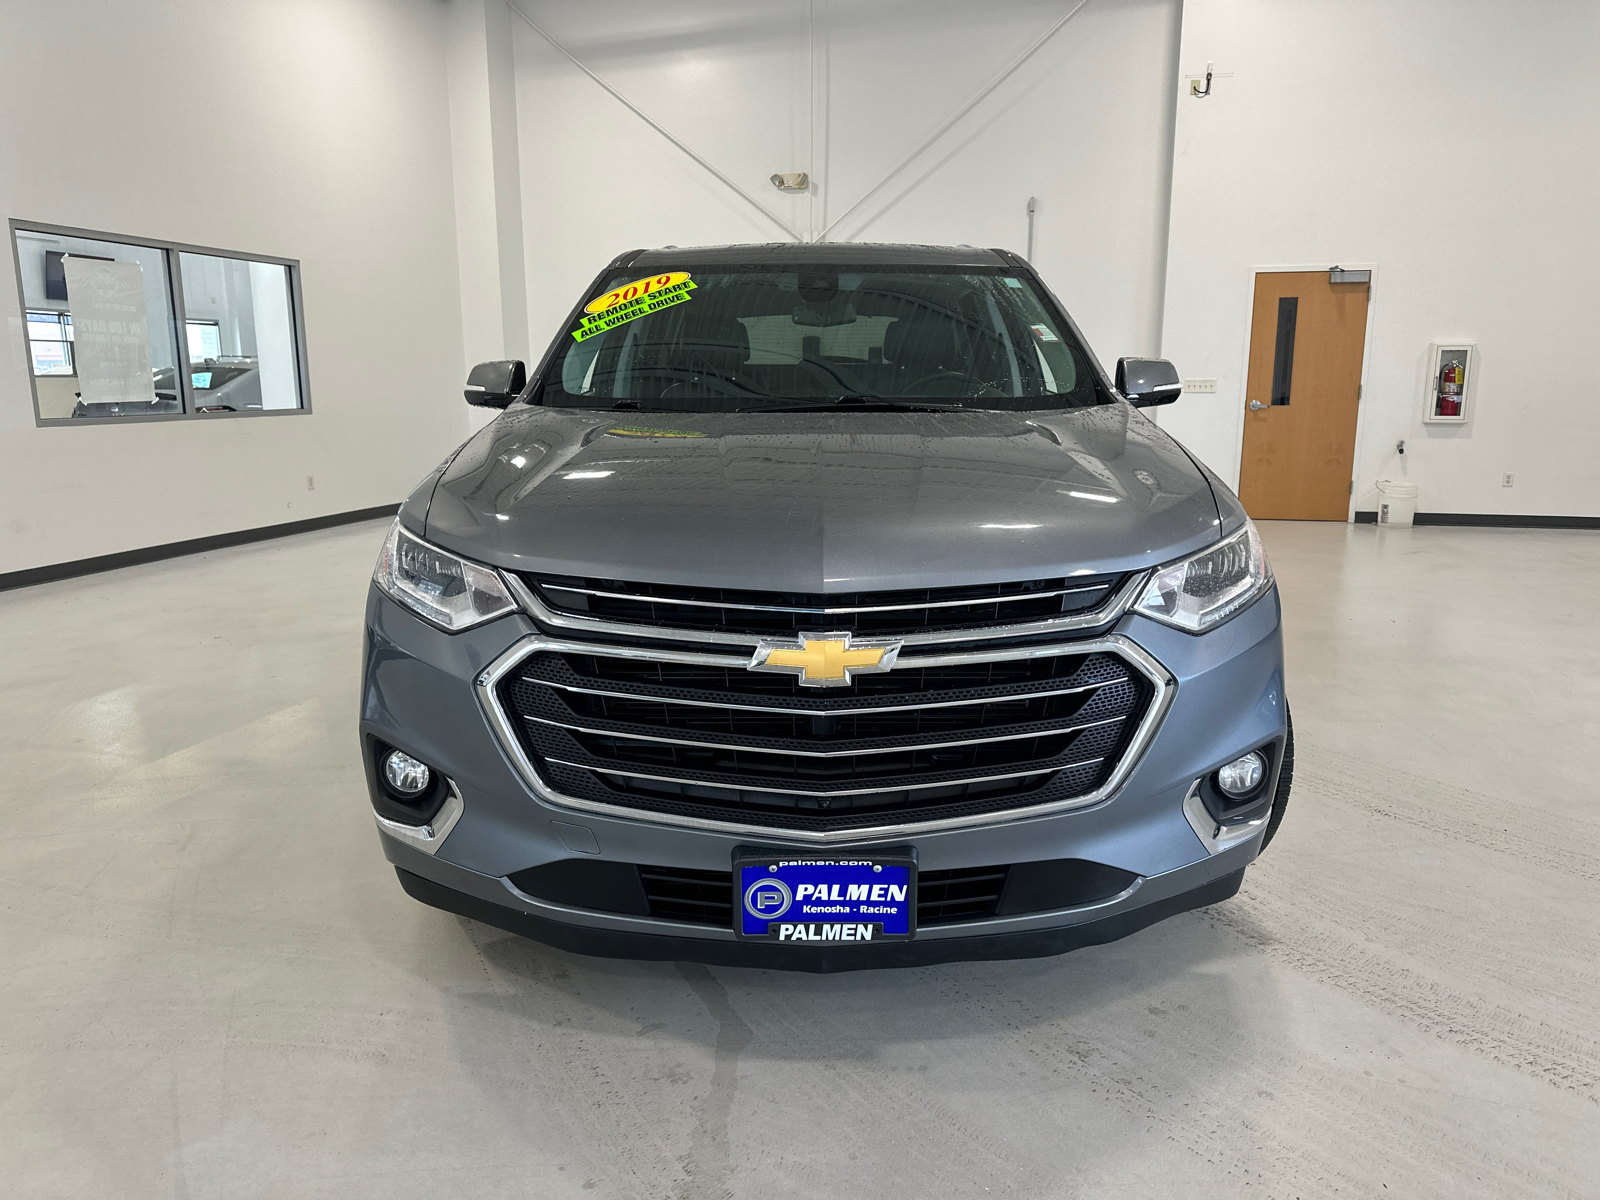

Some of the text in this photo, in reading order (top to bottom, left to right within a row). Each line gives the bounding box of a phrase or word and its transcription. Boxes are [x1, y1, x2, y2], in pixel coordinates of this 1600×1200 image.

[587, 281, 691, 325] REMOTE START
[606, 276, 671, 309] 2019
[580, 293, 687, 339] ALL WHEEL DRIVE
[795, 884, 908, 902] PALMEN
[802, 905, 850, 913] Kenosha
[859, 905, 898, 914] Racine
[778, 924, 873, 941] PALMEN
